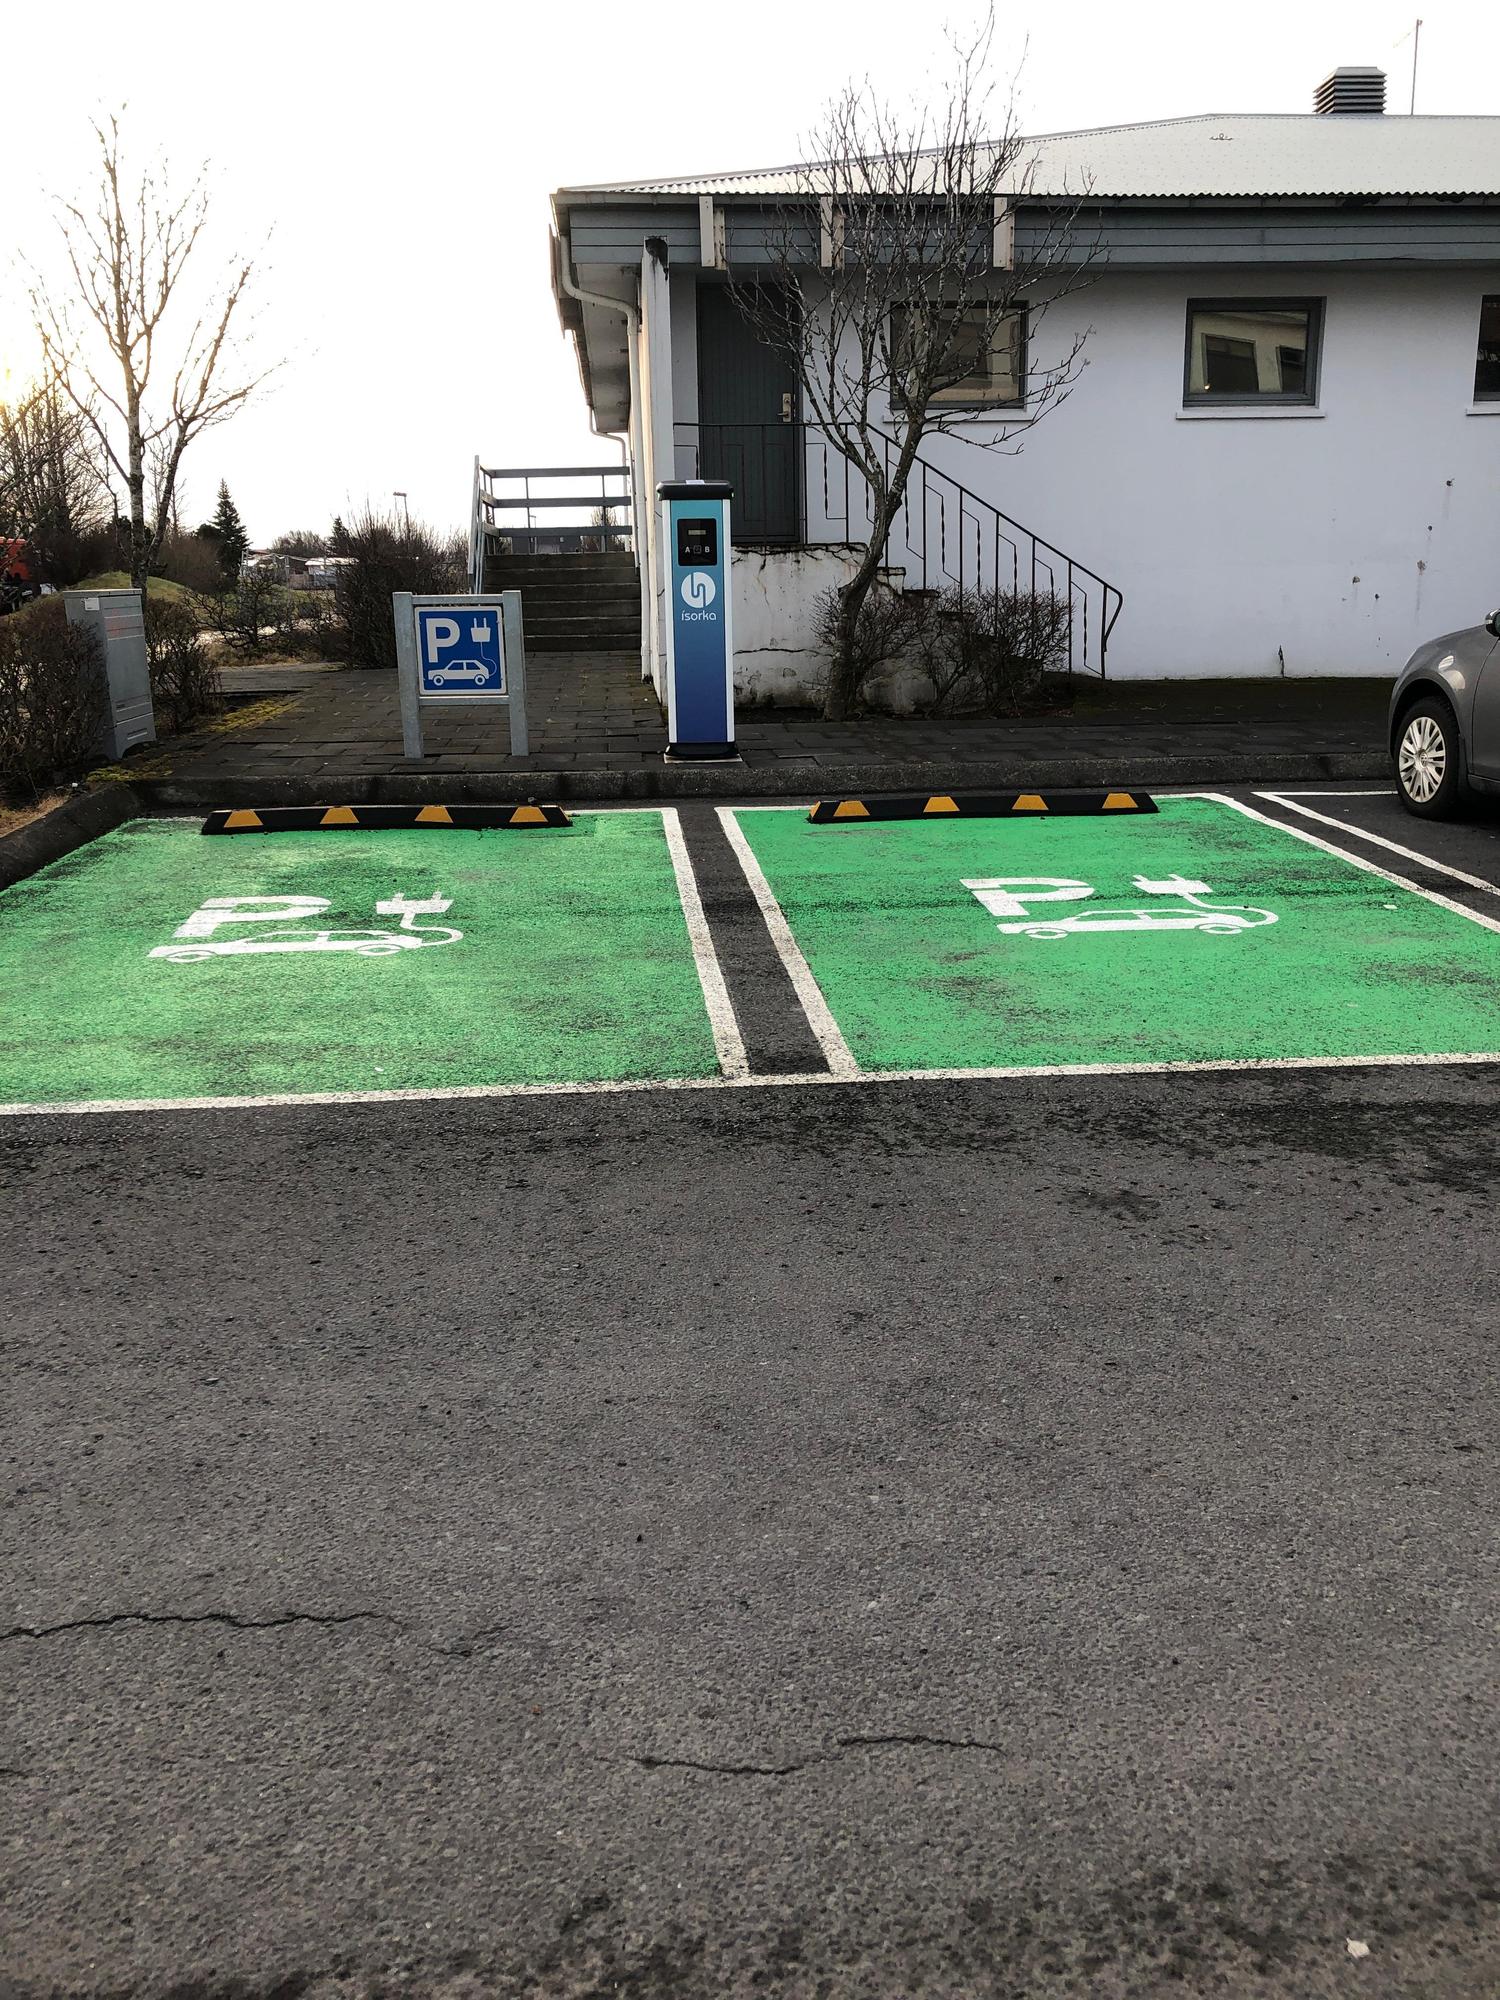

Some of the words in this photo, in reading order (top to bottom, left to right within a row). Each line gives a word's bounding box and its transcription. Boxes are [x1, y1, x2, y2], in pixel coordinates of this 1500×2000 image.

[425, 617, 461, 663] P
[172, 895, 332, 938] P
[958, 877, 1095, 916] P
